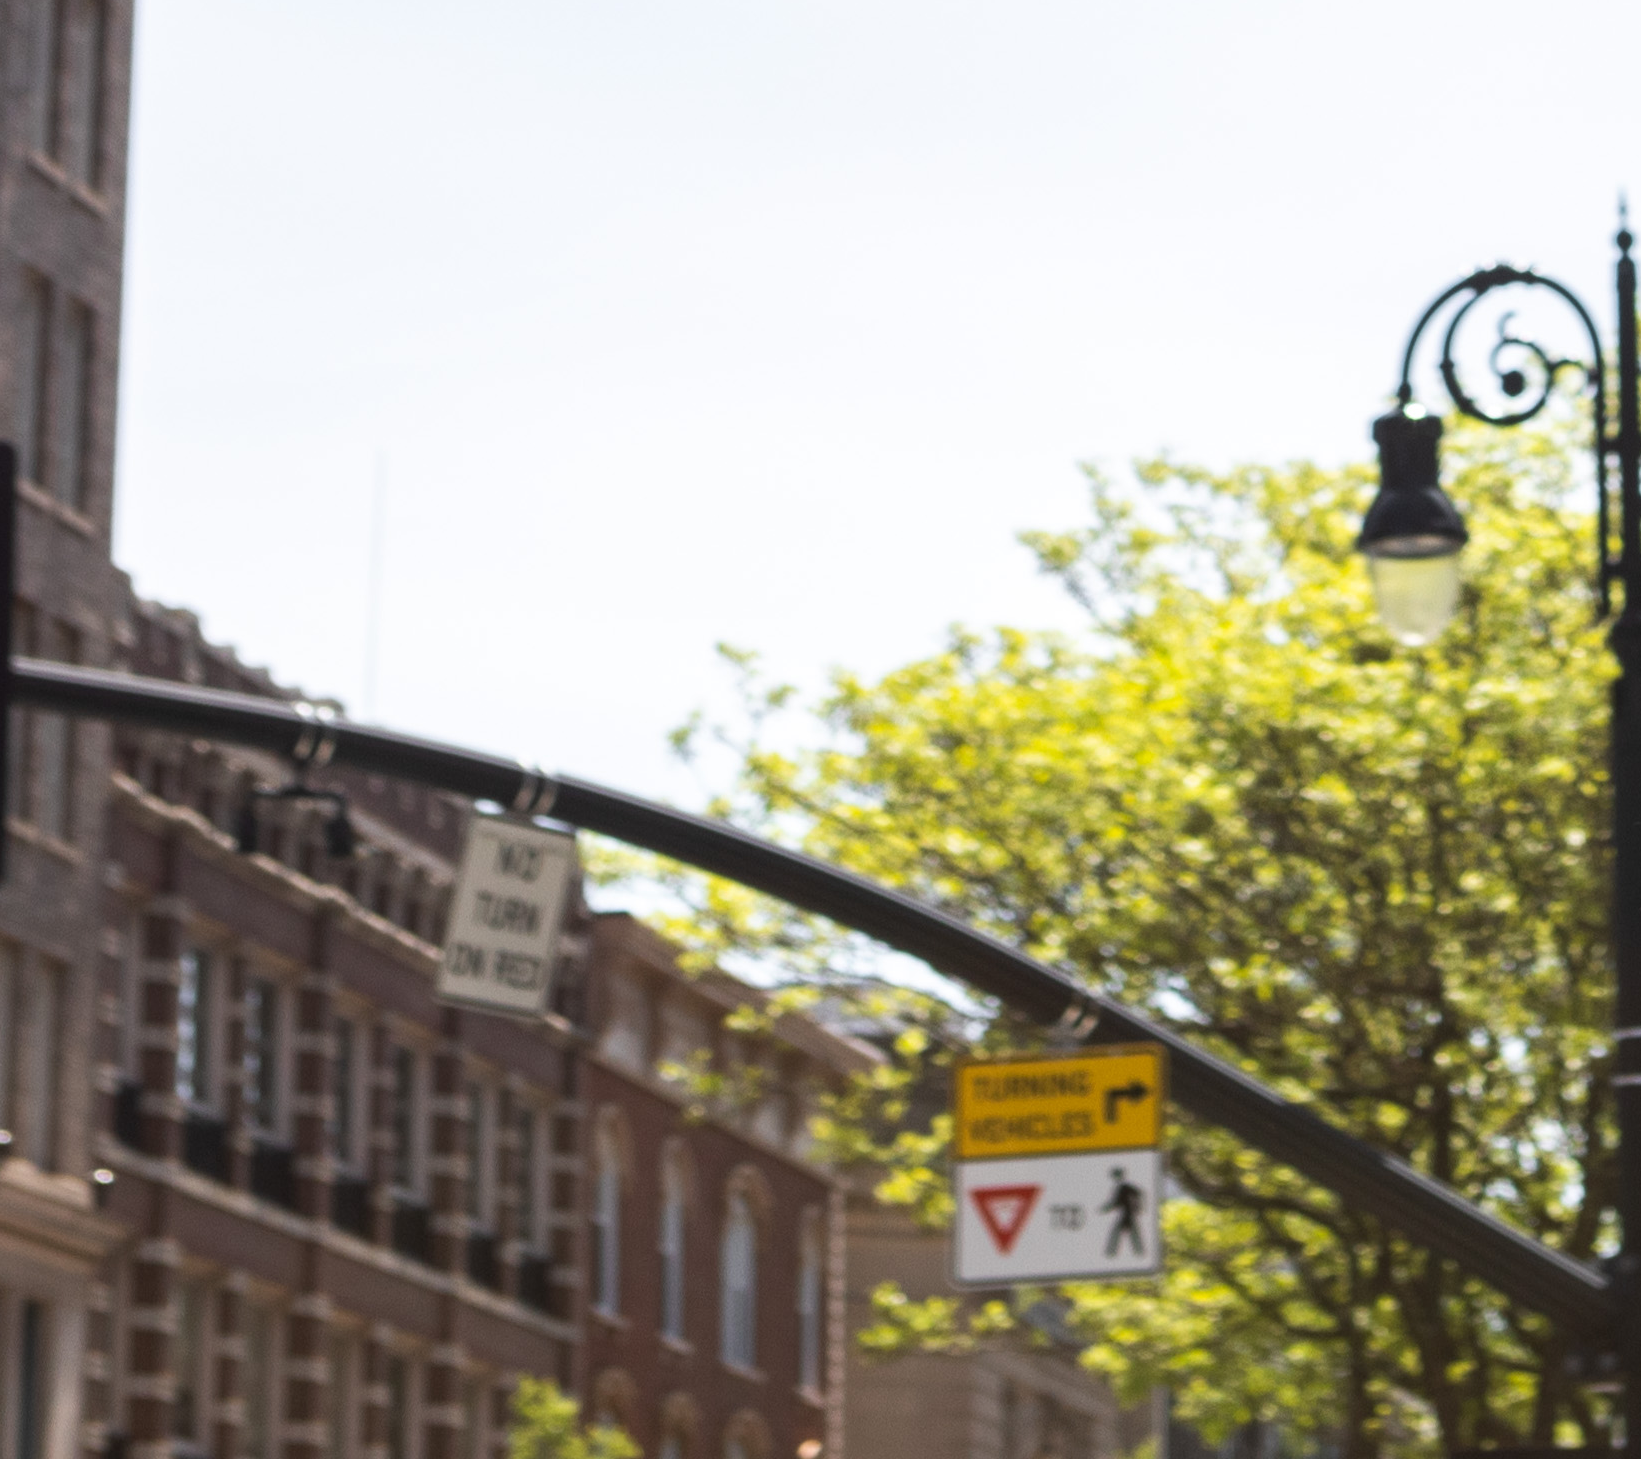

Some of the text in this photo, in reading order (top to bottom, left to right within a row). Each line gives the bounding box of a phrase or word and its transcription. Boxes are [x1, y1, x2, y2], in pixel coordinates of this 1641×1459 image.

[498, 843, 542, 882] NO
[473, 889, 541, 935] TURN
[449, 941, 543, 991] ON RED
[971, 1071, 1091, 1102] TURNING
[970, 1110, 1094, 1144] VEHICLES
[1050, 1203, 1085, 1232] TO
